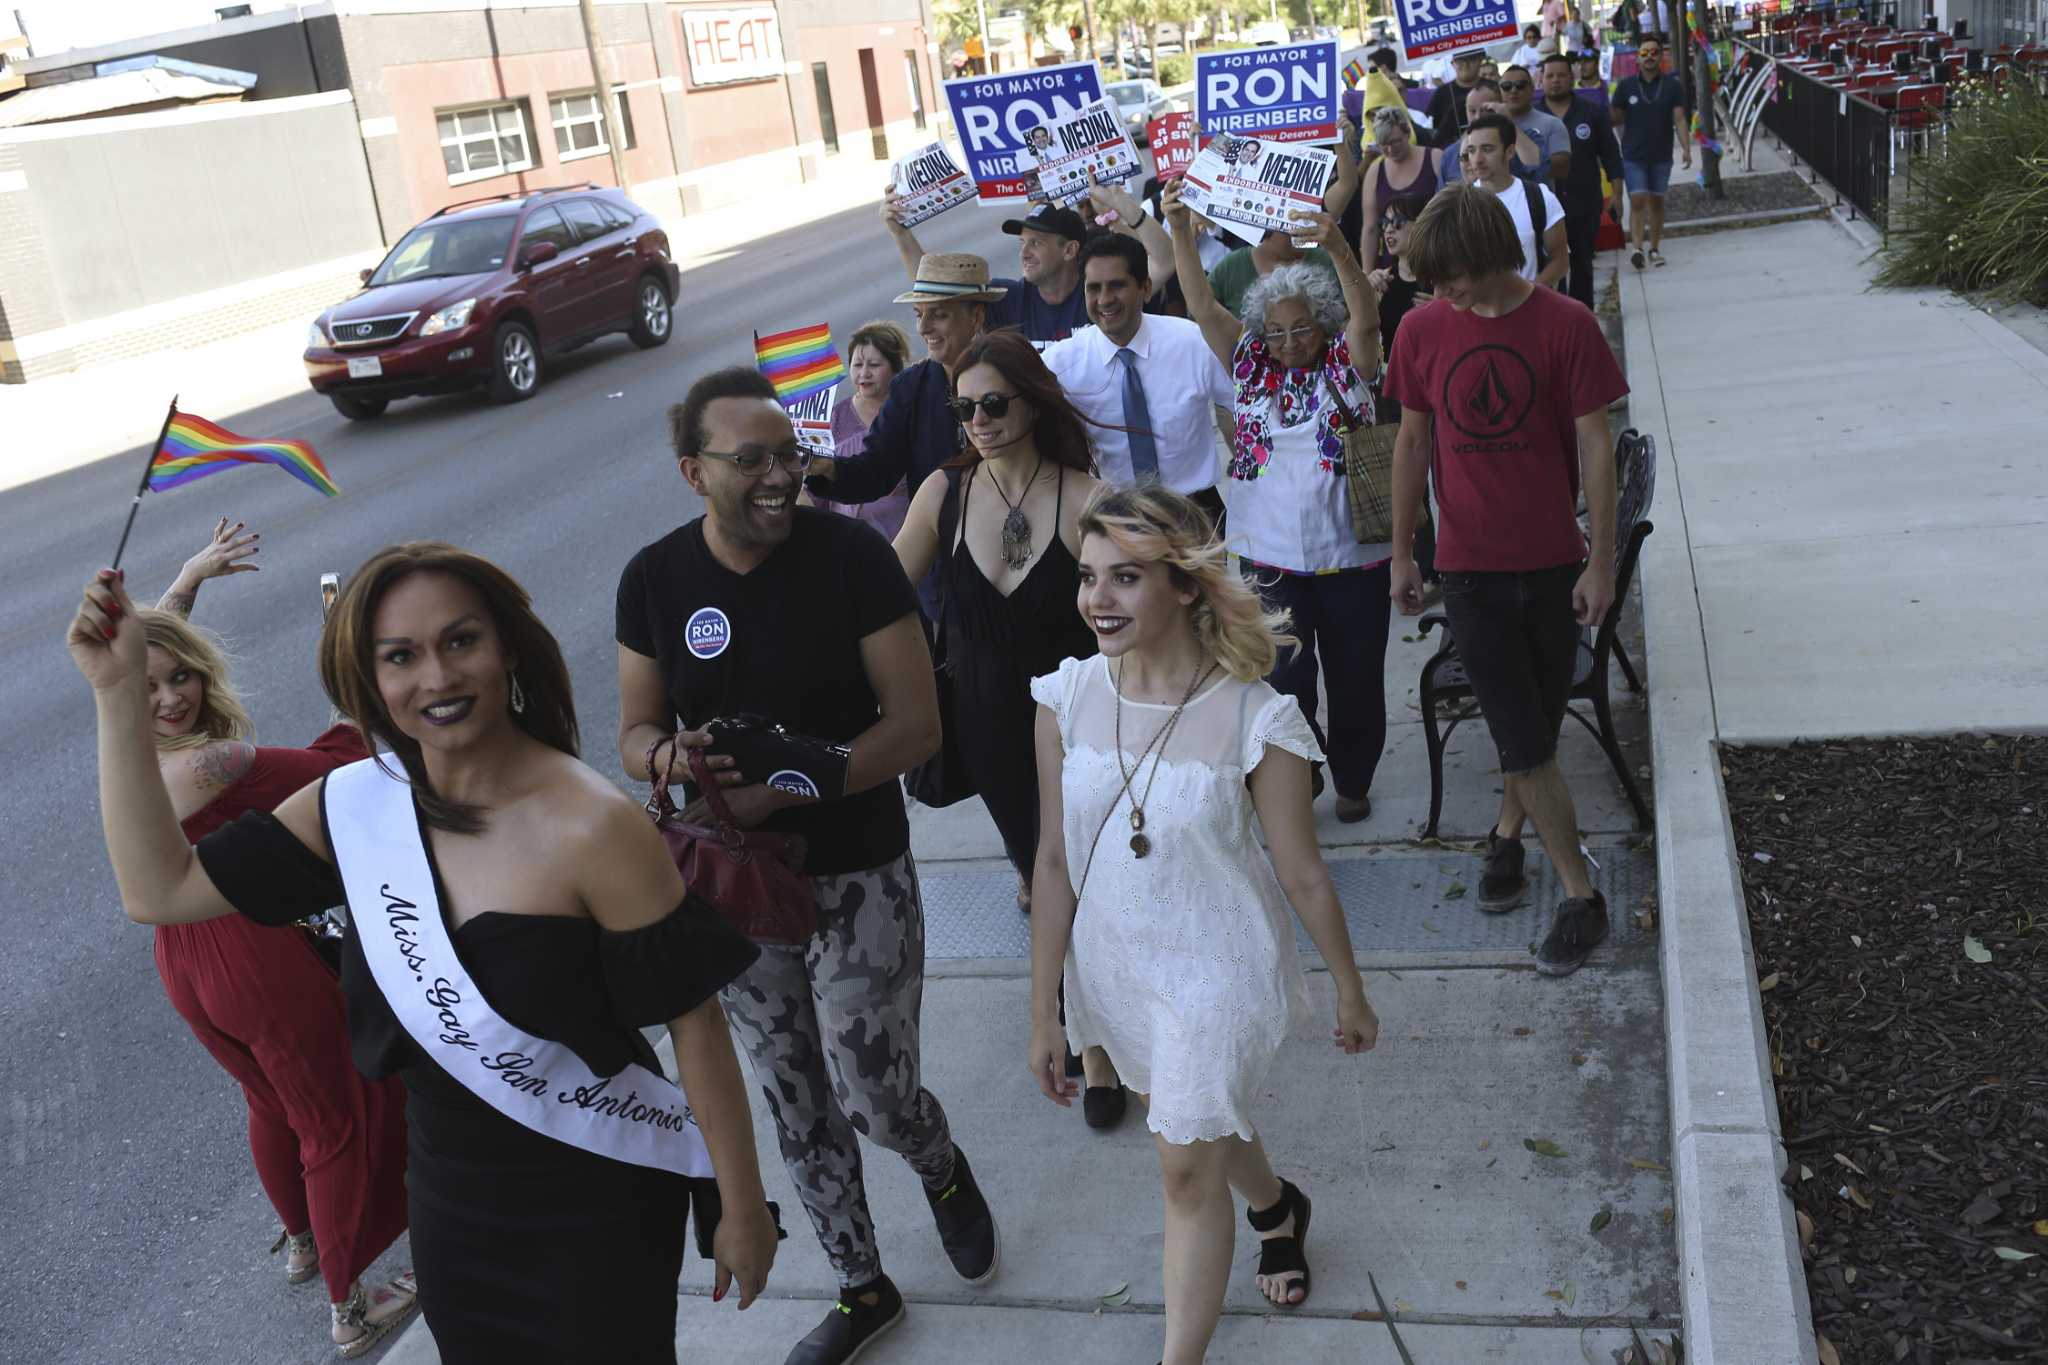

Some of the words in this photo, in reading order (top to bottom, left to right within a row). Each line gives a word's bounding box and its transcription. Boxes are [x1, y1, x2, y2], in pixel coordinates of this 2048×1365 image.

[1409, 10, 1508, 45] NIRENBERG
[690, 18, 773, 66] HEAT
[1421, 45, 1436, 54] The
[1437, 40, 1454, 51] City
[1455, 36, 1470, 47] You
[1471, 30, 1504, 43] Deserve
[1224, 55, 1252, 69] FOR
[1256, 49, 1308, 65] MAYOR
[974, 83, 1004, 99] FOR
[1008, 73, 1066, 95] MAYOR
[1206, 61, 1328, 112] RON
[1057, 110, 1120, 154] MEDINA
[1207, 105, 1328, 133] NIRENBERG
[1279, 128, 1320, 141] Deserve
[904, 149, 959, 193] MEDINA
[1038, 146, 1100, 172] ENDORSEMENTS
[1223, 176, 1292, 198] ENDORSEMENTS
[1258, 152, 1327, 197] MEDINA
[996, 183, 1014, 194] The
[1213, 205, 1229, 217] NEW
[1229, 208, 1253, 222] MAYOR
[1253, 215, 1267, 225] FOR
[786, 389, 831, 421] DINA
[692, 622, 724, 638] RON
[426, 977, 478, 1051] Gay
[480, 1051, 548, 1097] San
[558, 1078, 684, 1133] Antonio
